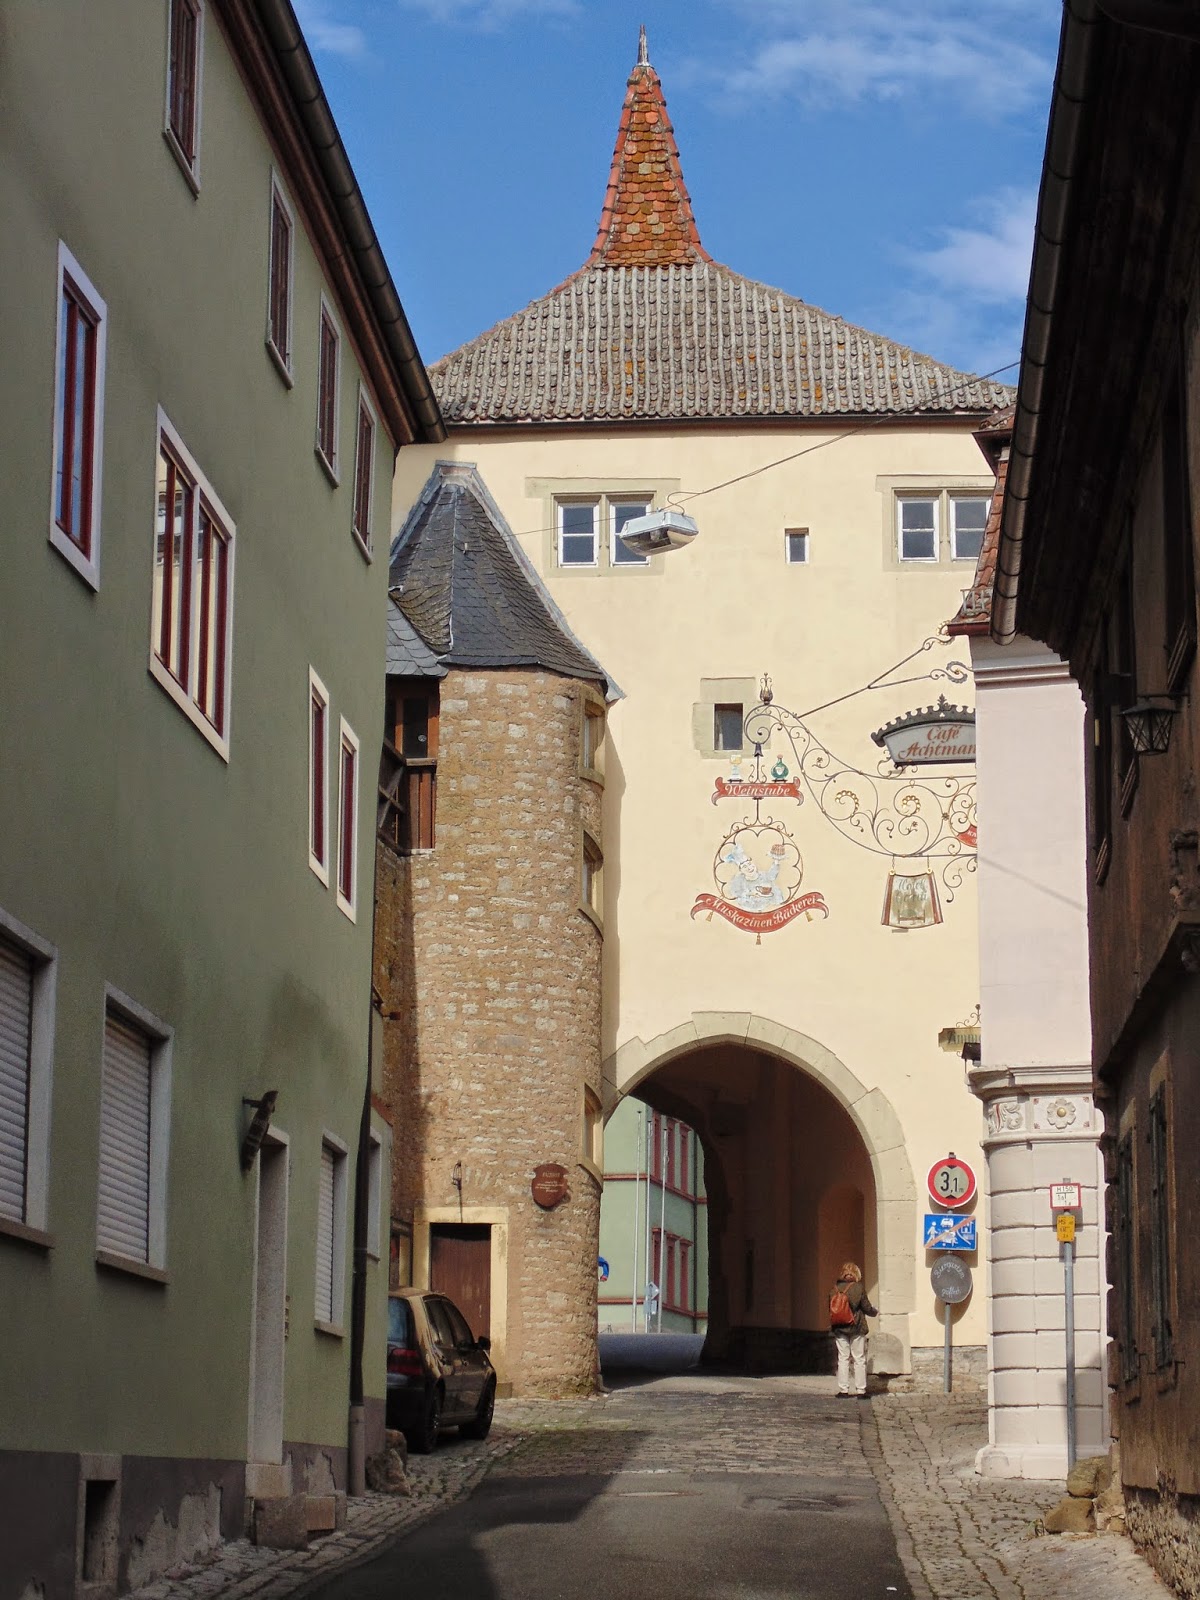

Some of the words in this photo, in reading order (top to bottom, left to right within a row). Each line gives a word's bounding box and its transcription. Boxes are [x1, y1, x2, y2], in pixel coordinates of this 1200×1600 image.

[926, 724, 962, 741] Café
[724, 784, 791, 796] Weinstube
[705, 898, 773, 927] Muskazinen
[773, 895, 816, 923] Bäckerei
